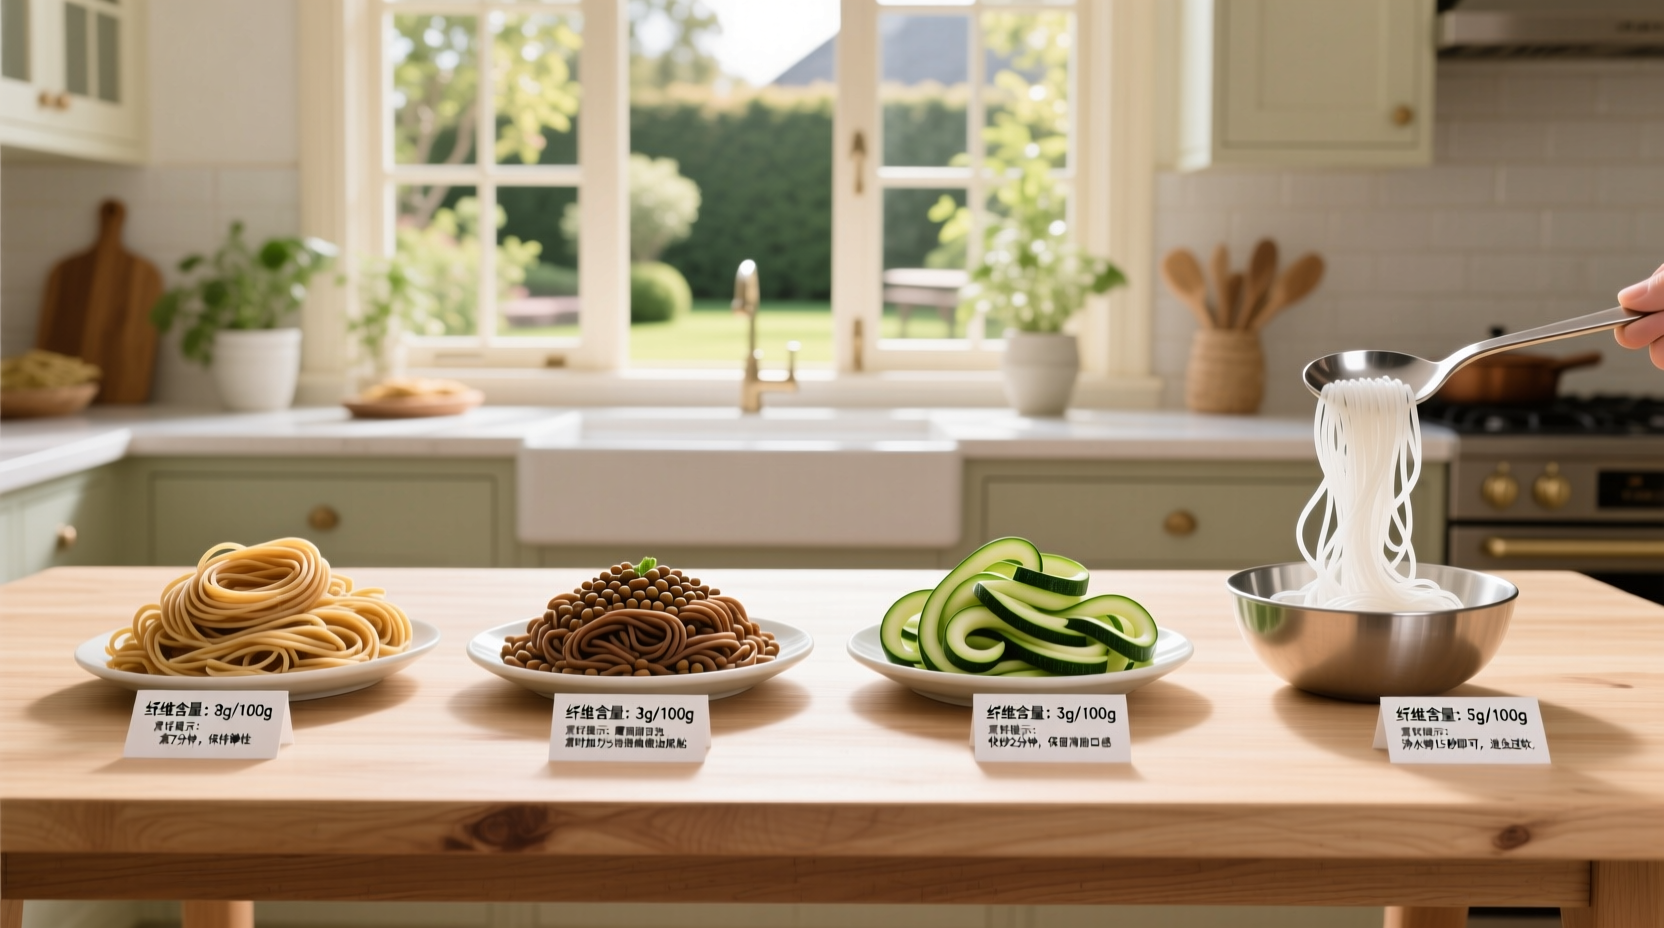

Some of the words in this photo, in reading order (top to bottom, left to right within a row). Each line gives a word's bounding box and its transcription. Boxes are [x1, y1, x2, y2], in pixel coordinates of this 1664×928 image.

[635, 706, 694, 724] 3g/100g
[1056, 706, 1116, 724] 3g/100g
[1467, 707, 1528, 725] 5g/100g
